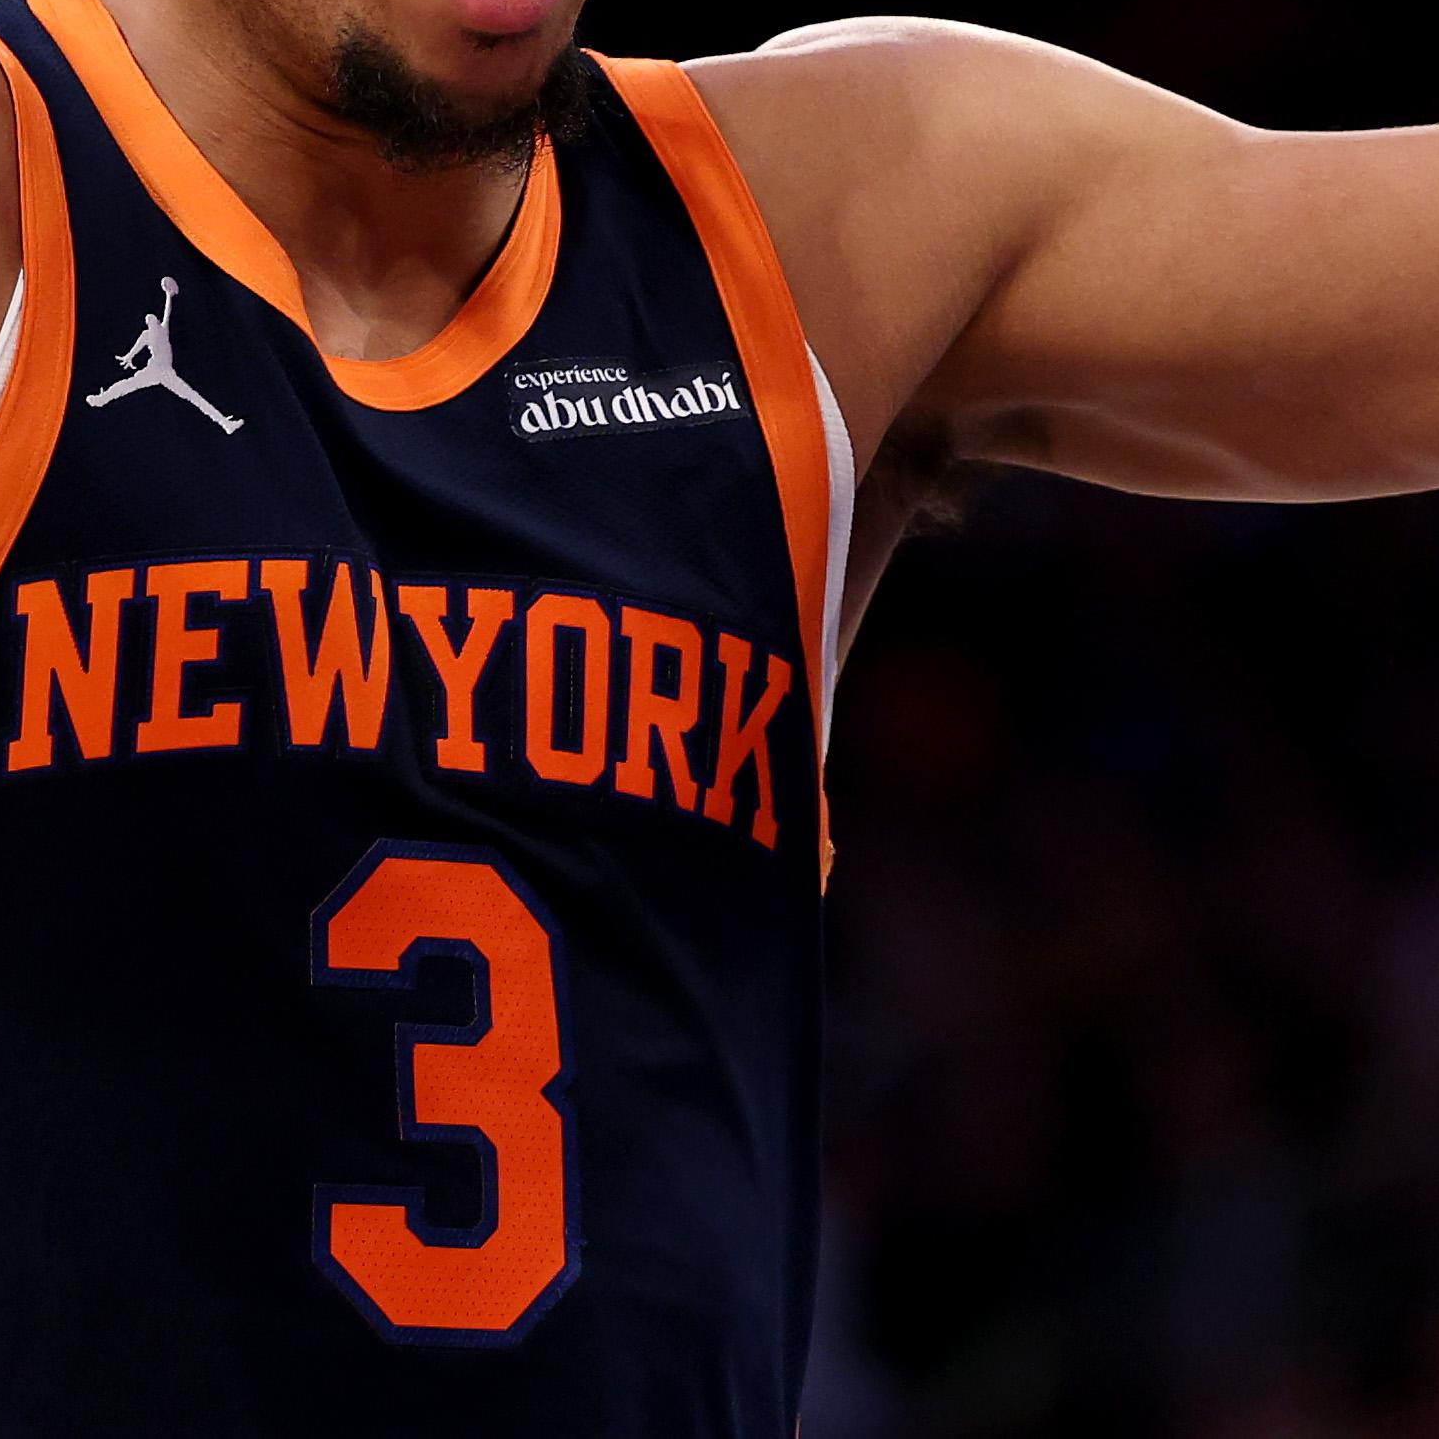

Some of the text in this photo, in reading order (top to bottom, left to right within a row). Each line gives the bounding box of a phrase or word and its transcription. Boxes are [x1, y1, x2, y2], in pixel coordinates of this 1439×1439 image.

[514, 364, 630, 391] experience
[519, 371, 742, 434] abu dhabi
[7, 560, 792, 851] NEW YORK
[325, 855, 568, 1333] 3
